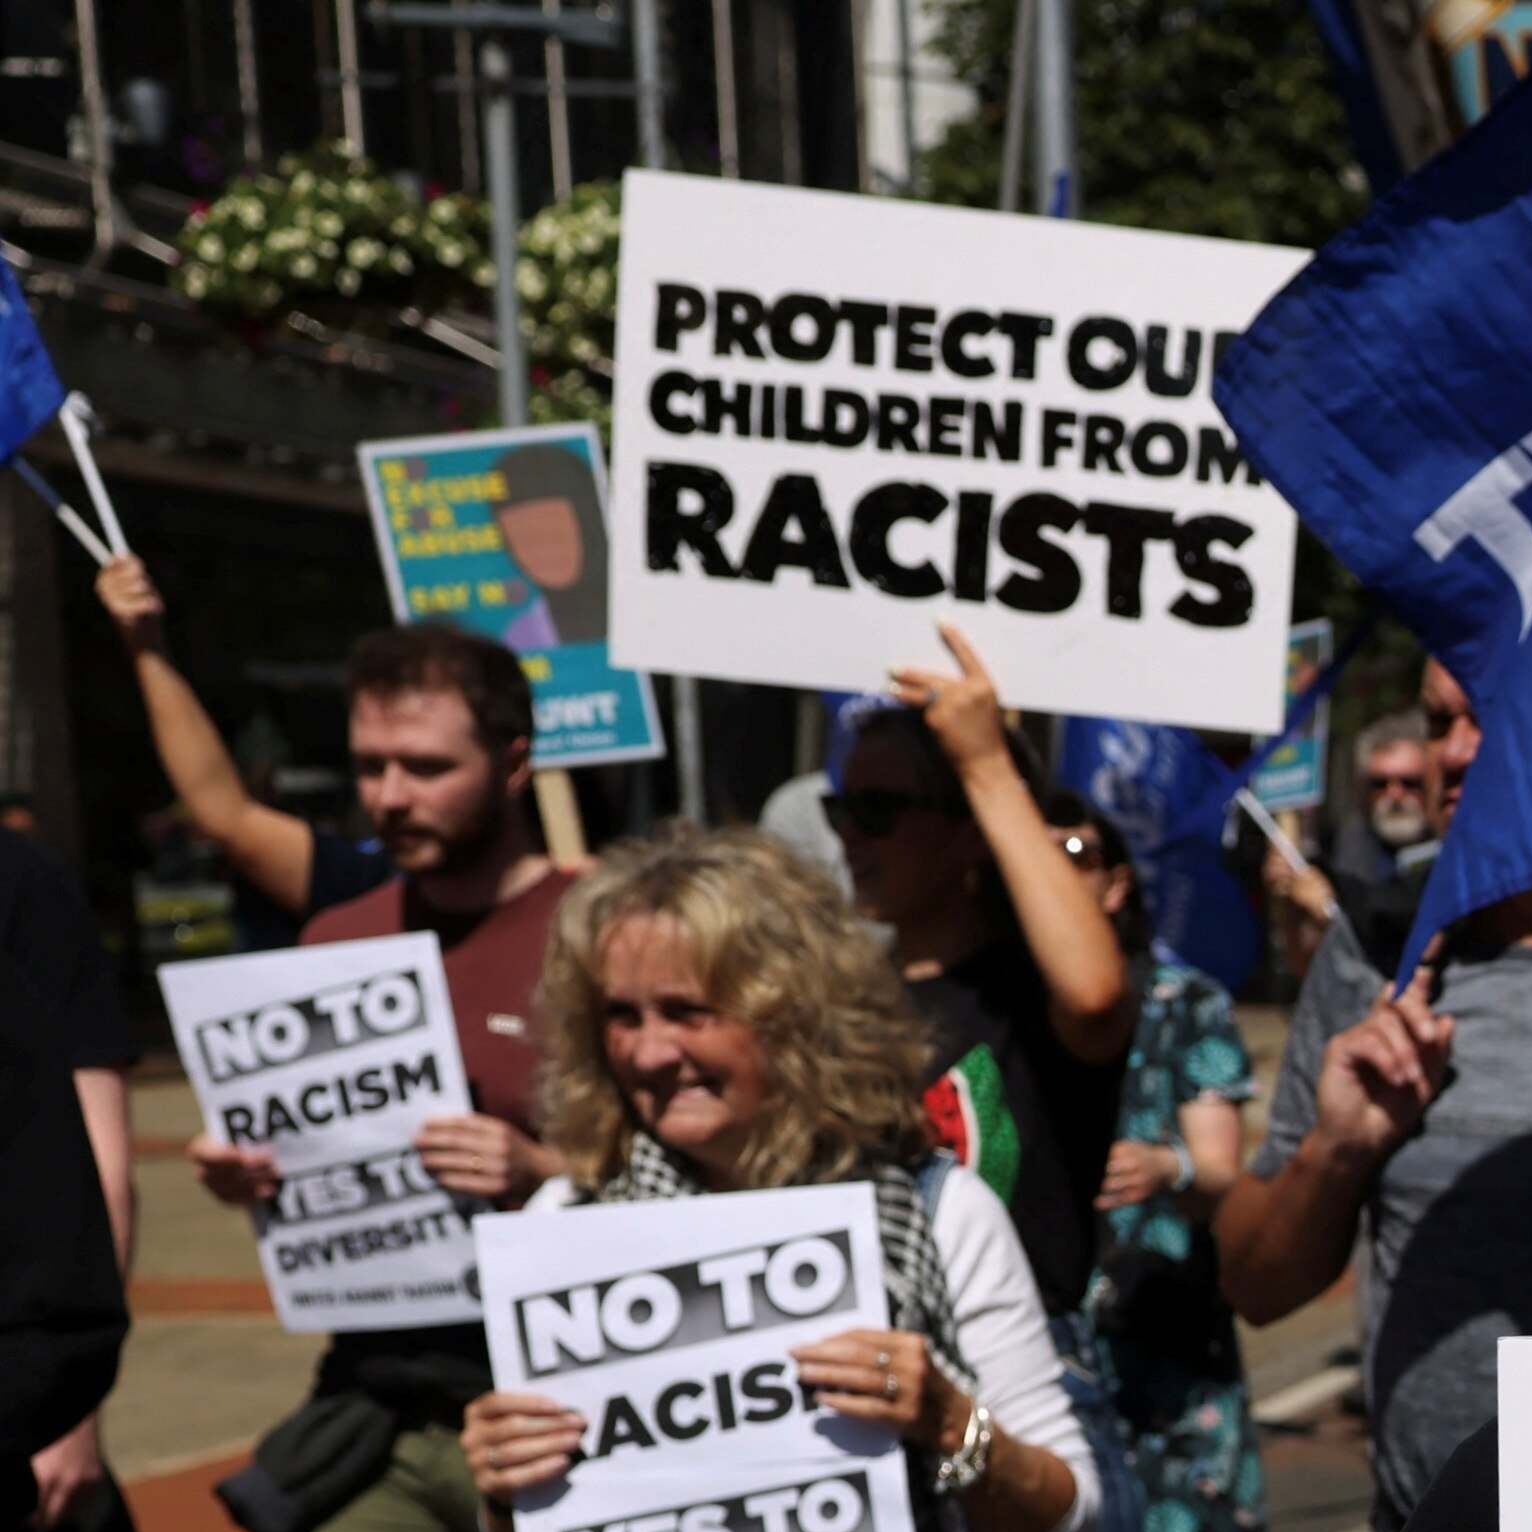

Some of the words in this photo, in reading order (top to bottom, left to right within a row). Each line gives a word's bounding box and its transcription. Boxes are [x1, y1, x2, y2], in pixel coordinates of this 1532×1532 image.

[653, 281, 1053, 380] PROTECT
[648, 371, 1022, 463] CHILDREN
[1041, 409, 1262, 486] FROM
[646, 460, 1256, 629] RACISTS
[200, 1001, 309, 1081] NO
[312, 972, 422, 1046] TO
[222, 1052, 443, 1147] RACISM
[520, 1271, 683, 1373] NO
[698, 1236, 848, 1331] TO
[568, 1361, 821, 1466] ACIS
